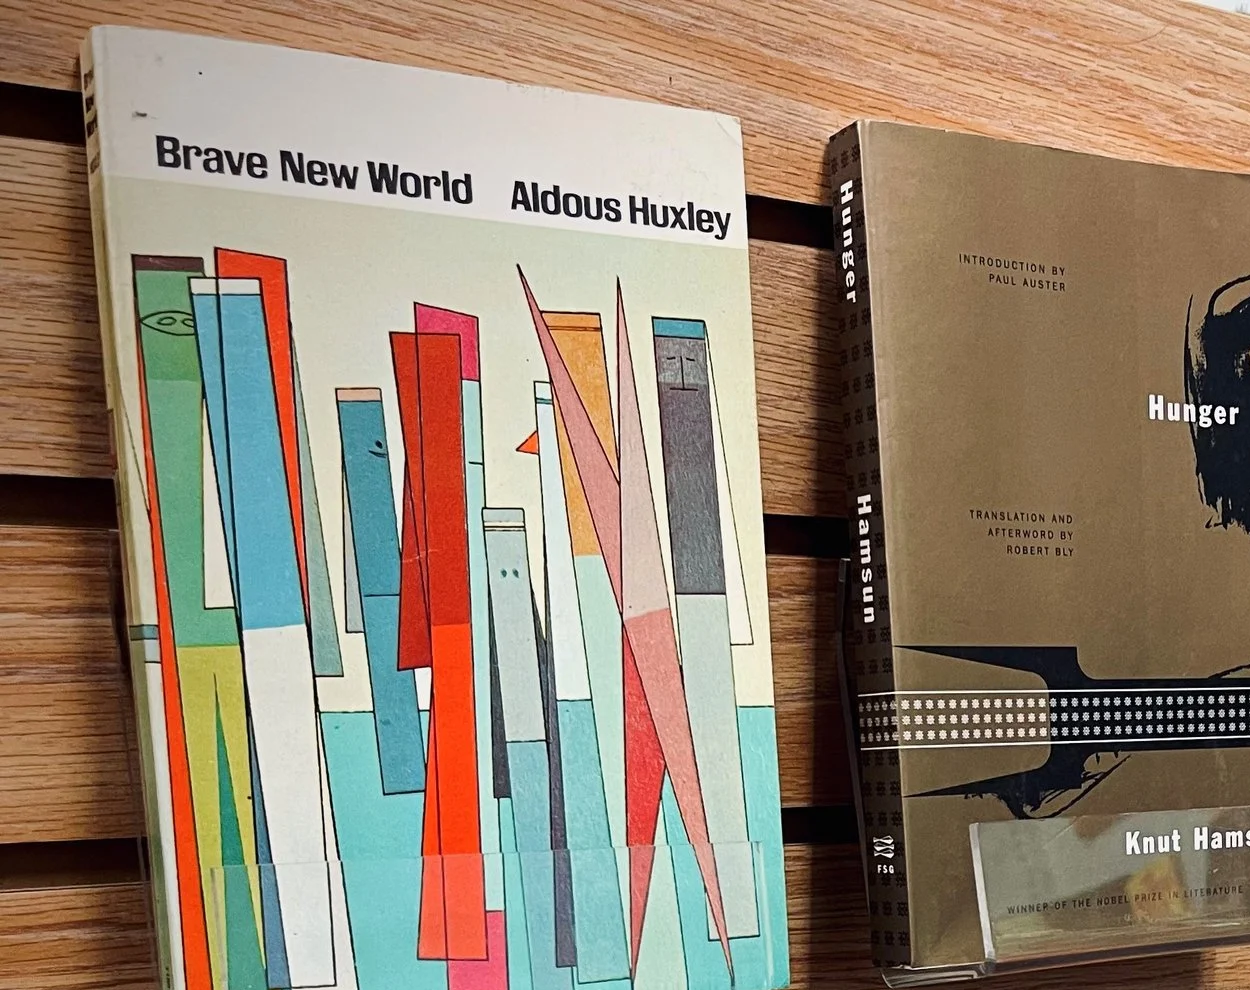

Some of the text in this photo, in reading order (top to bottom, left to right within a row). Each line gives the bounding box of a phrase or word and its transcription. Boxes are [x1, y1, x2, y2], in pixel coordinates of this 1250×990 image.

[156, 135, 474, 204] Brave New World
[511, 181, 731, 240] Aldous Huxley
[839, 180, 858, 303] Hunger
[959, 253, 1065, 276] INTRODUCTION BY
[989, 273, 1066, 292] PAUL AUSTER
[1148, 394, 1240, 428] Hunger
[969, 509, 1073, 524] TRANSLATION AND
[988, 527, 1074, 540] AFTERWORD BY
[857, 494, 875, 624] Hamsun
[1006, 545, 1074, 557] ROBERT BLY
[1125, 828, 1181, 855] Knut
[877, 864, 895, 874] FSG
[1007, 885, 1244, 914] WINNER OF THE NOBEL PRIZE IN LITERATURE
